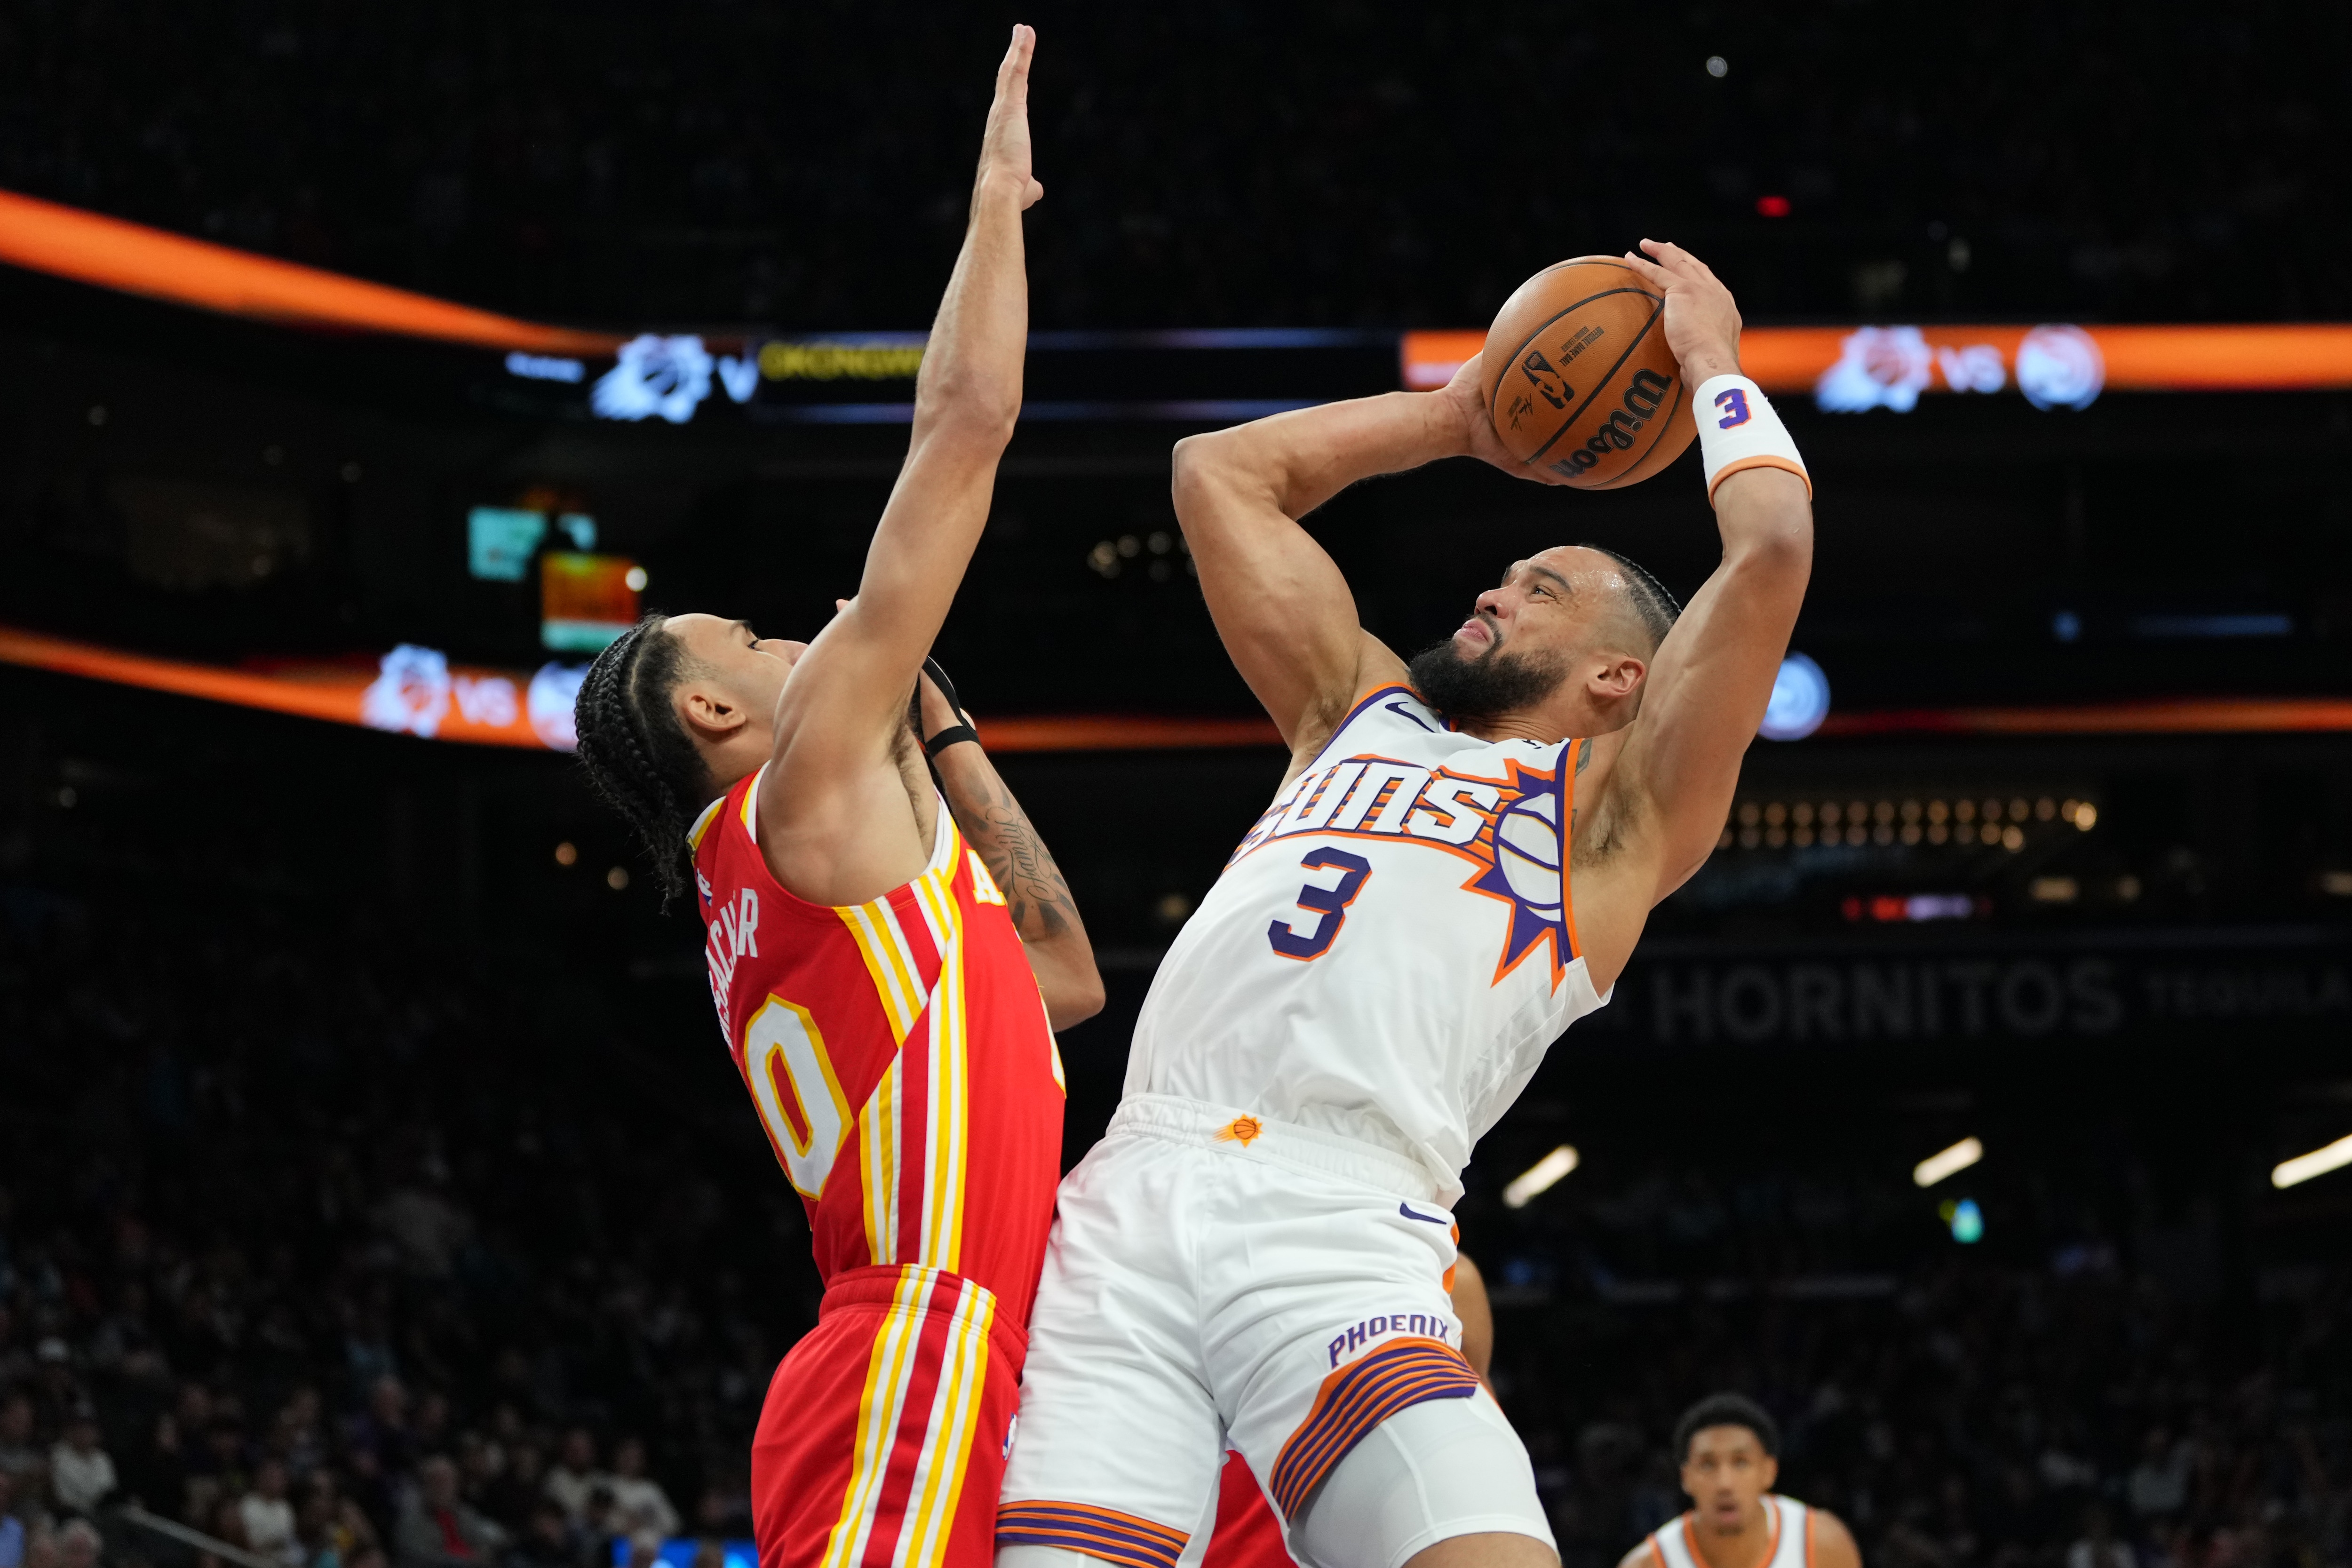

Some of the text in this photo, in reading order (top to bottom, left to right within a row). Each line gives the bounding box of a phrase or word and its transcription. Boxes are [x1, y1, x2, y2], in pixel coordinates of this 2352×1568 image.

[717, 353, 758, 405] V
[1559, 352, 1574, 367] BALL
[1549, 368, 1673, 478] Wilson
[1714, 388, 1752, 430] 3
[1268, 846, 1373, 963] 3
[1650, 958, 2125, 1043] HORNITOS
[744, 992, 854, 1202] 0
[1328, 1314, 1448, 1370] PHOENIX
